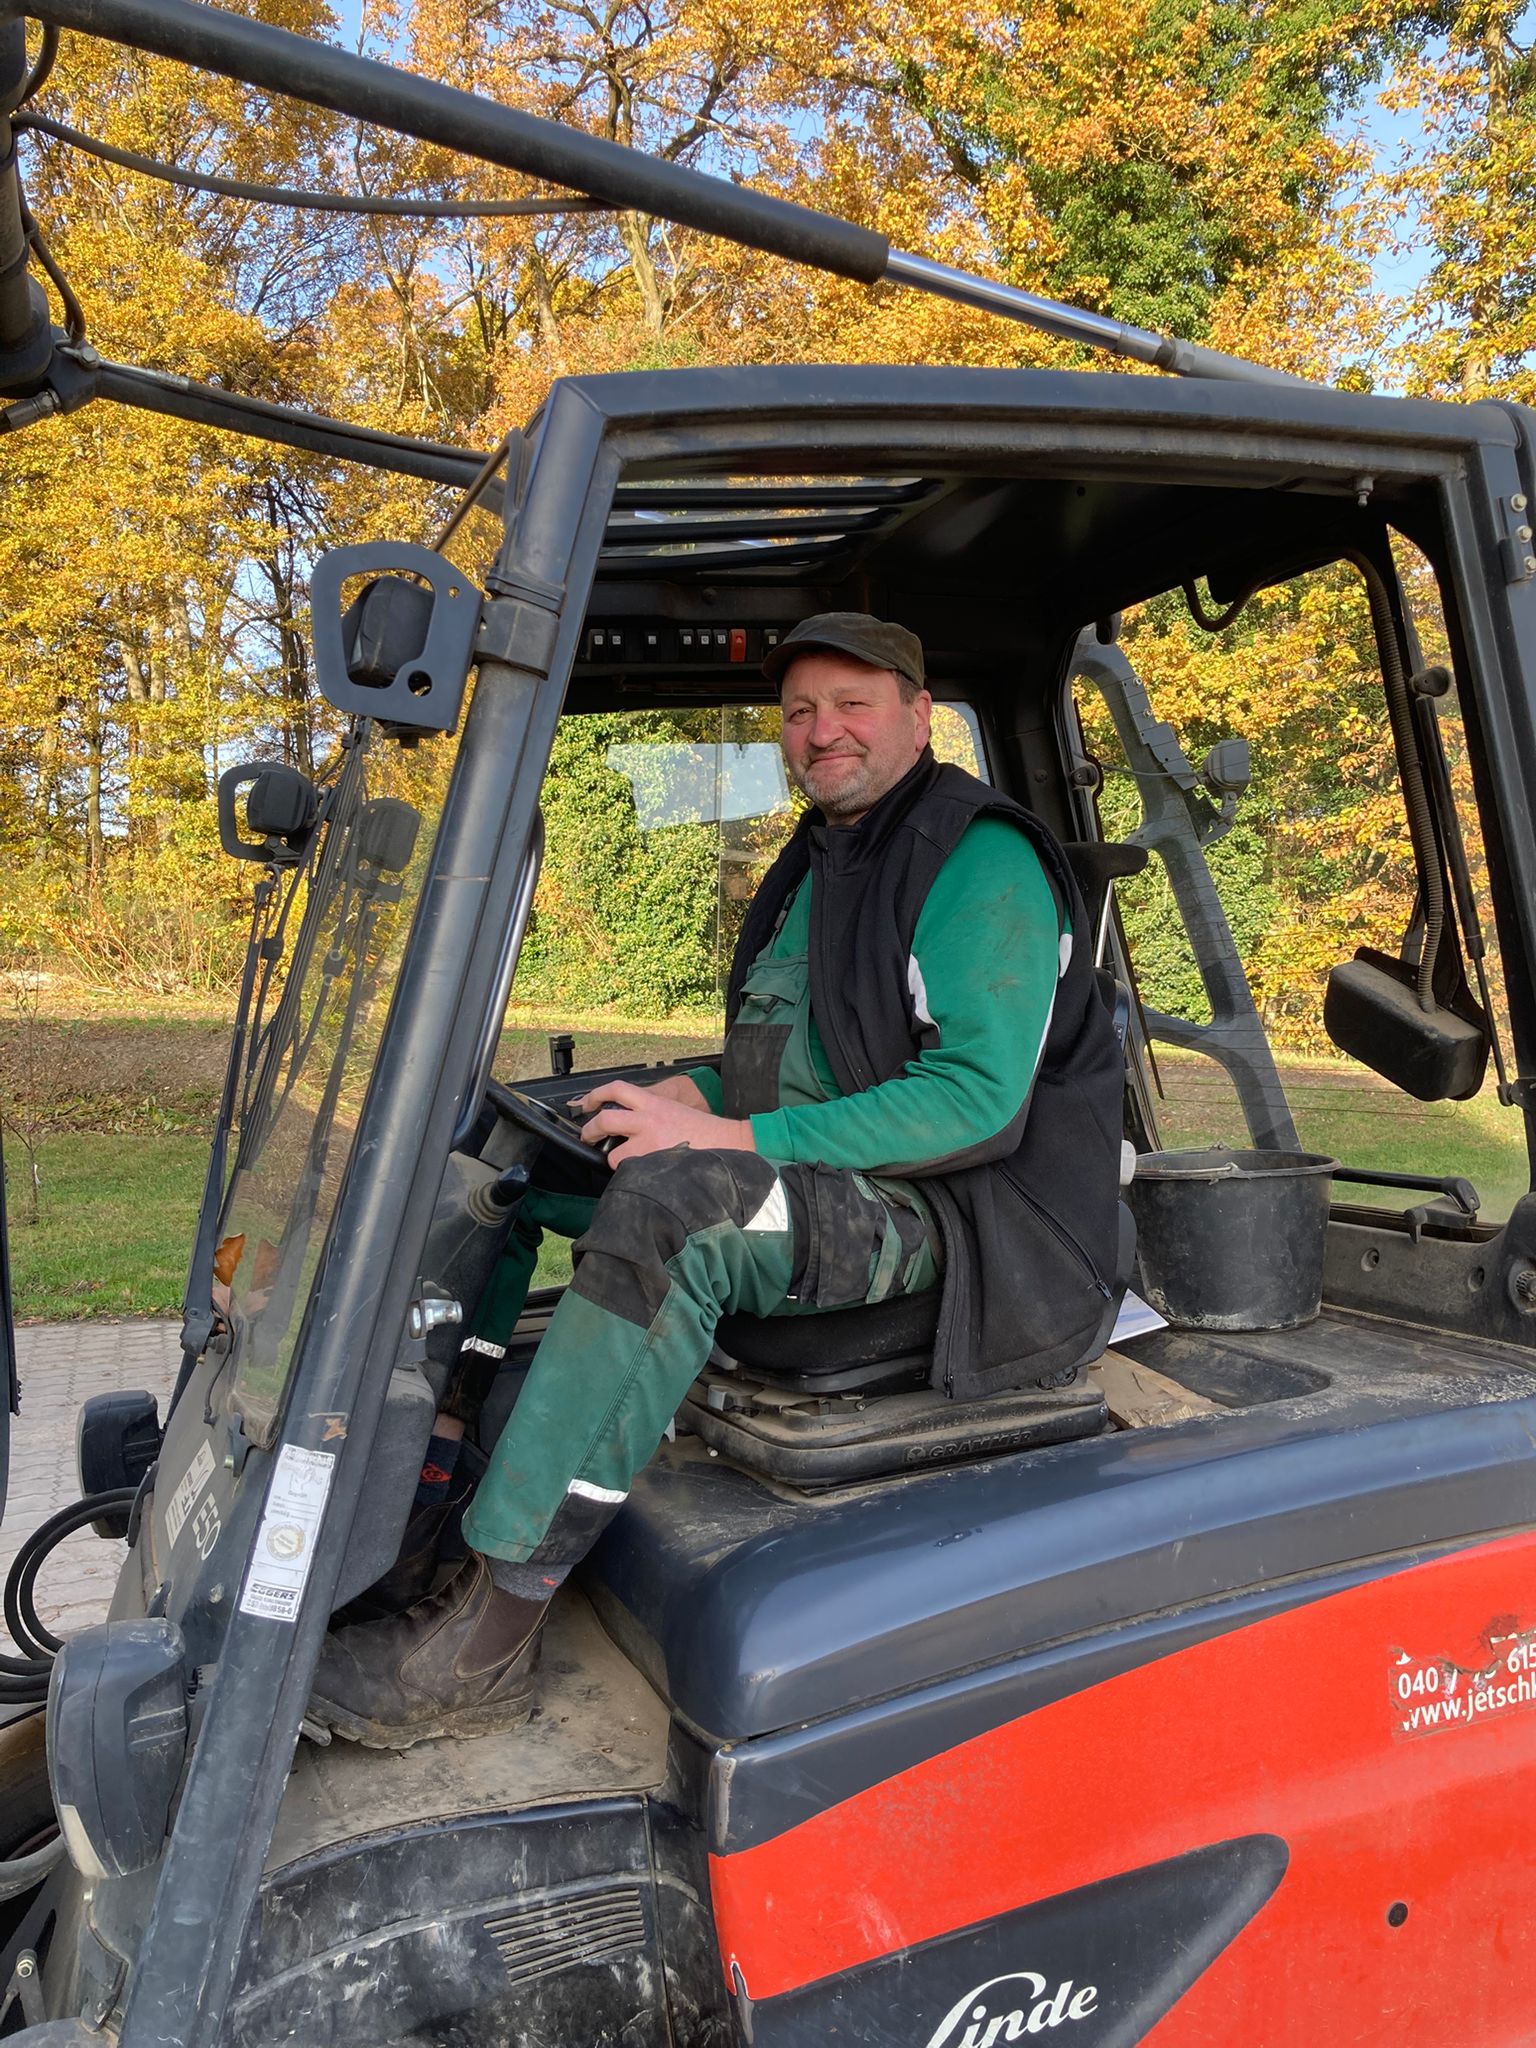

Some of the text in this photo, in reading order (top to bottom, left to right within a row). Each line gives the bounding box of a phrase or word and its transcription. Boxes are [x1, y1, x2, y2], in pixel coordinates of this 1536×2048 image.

[929, 1430, 1032, 1458] GRAMMER
[1398, 1666, 1439, 1699] 040
[925, 1971, 1099, 2048] Linde
